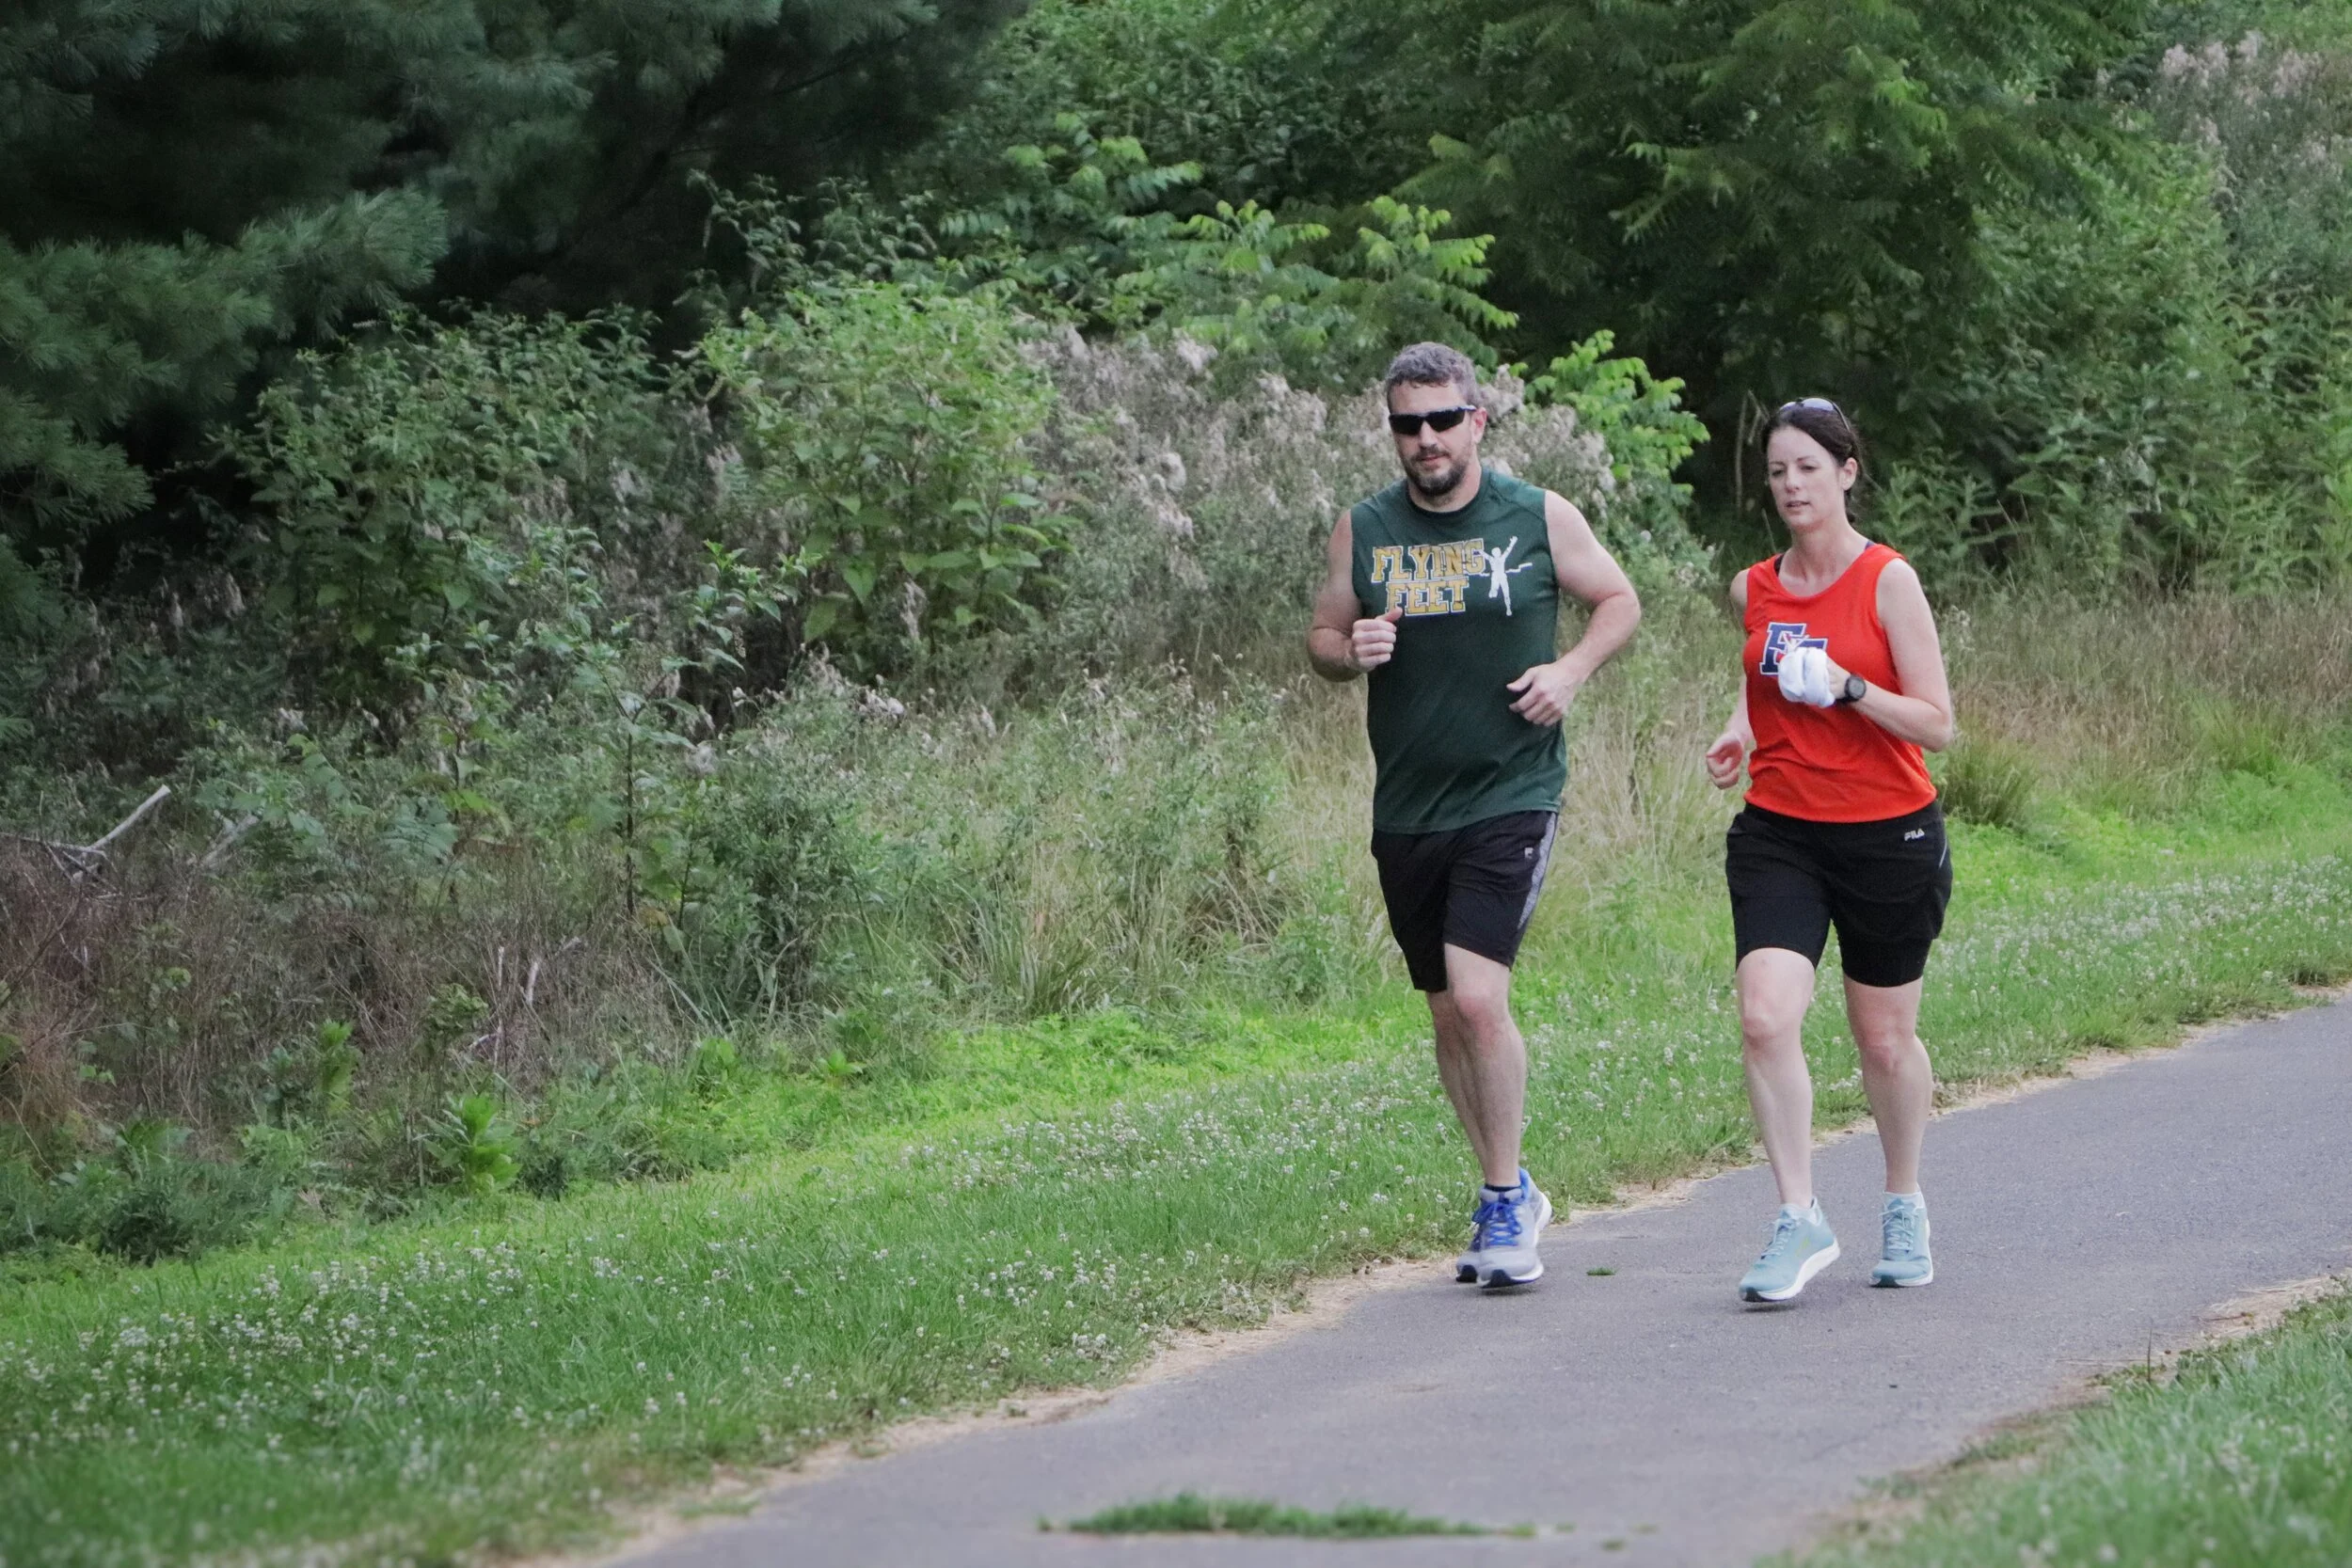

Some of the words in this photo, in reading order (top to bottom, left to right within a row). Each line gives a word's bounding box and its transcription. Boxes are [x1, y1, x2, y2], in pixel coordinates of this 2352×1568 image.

[1371, 538, 1486, 582] FLYING
[1385, 577, 1469, 616] FEET
[1904, 828, 1925, 841] FILA
